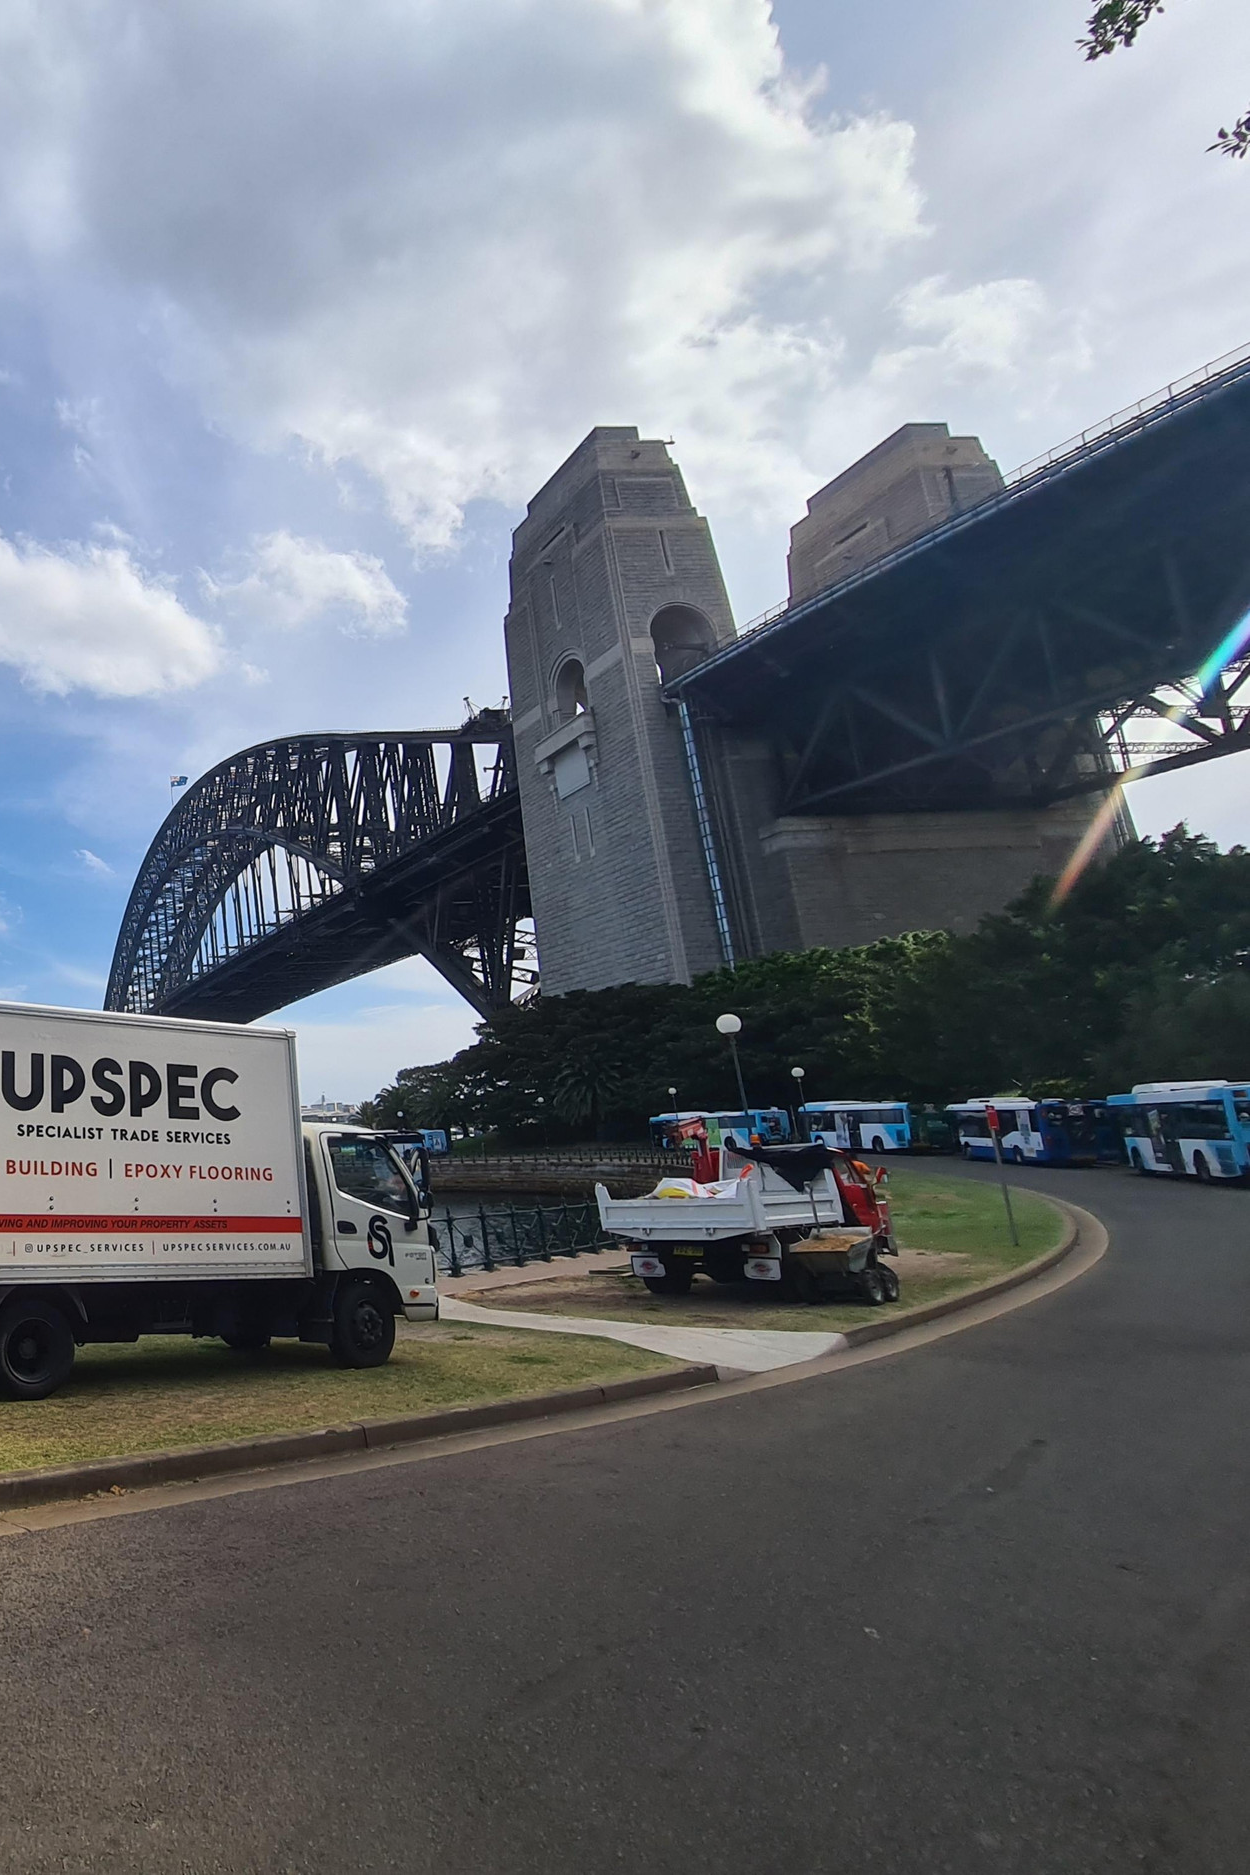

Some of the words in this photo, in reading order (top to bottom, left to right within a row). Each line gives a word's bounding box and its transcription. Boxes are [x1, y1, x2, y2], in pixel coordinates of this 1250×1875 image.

[1, 1050, 241, 1121] UPSPEC
[17, 1124, 103, 1140] SPECIALIST
[111, 1128, 159, 1142] TRADE
[166, 1131, 231, 1145] SERVICES
[6, 1159, 97, 1177] BUILDING
[124, 1163, 183, 1179] EPOXY
[189, 1165, 273, 1181] FLOORING
[26, 1219, 48, 1228] AND
[51, 1219, 108, 1229] IMPROVING
[111, 1219, 138, 1229] YOUR
[140, 1219, 190, 1229] PROPERTY
[193, 1219, 227, 1229] ASSETS
